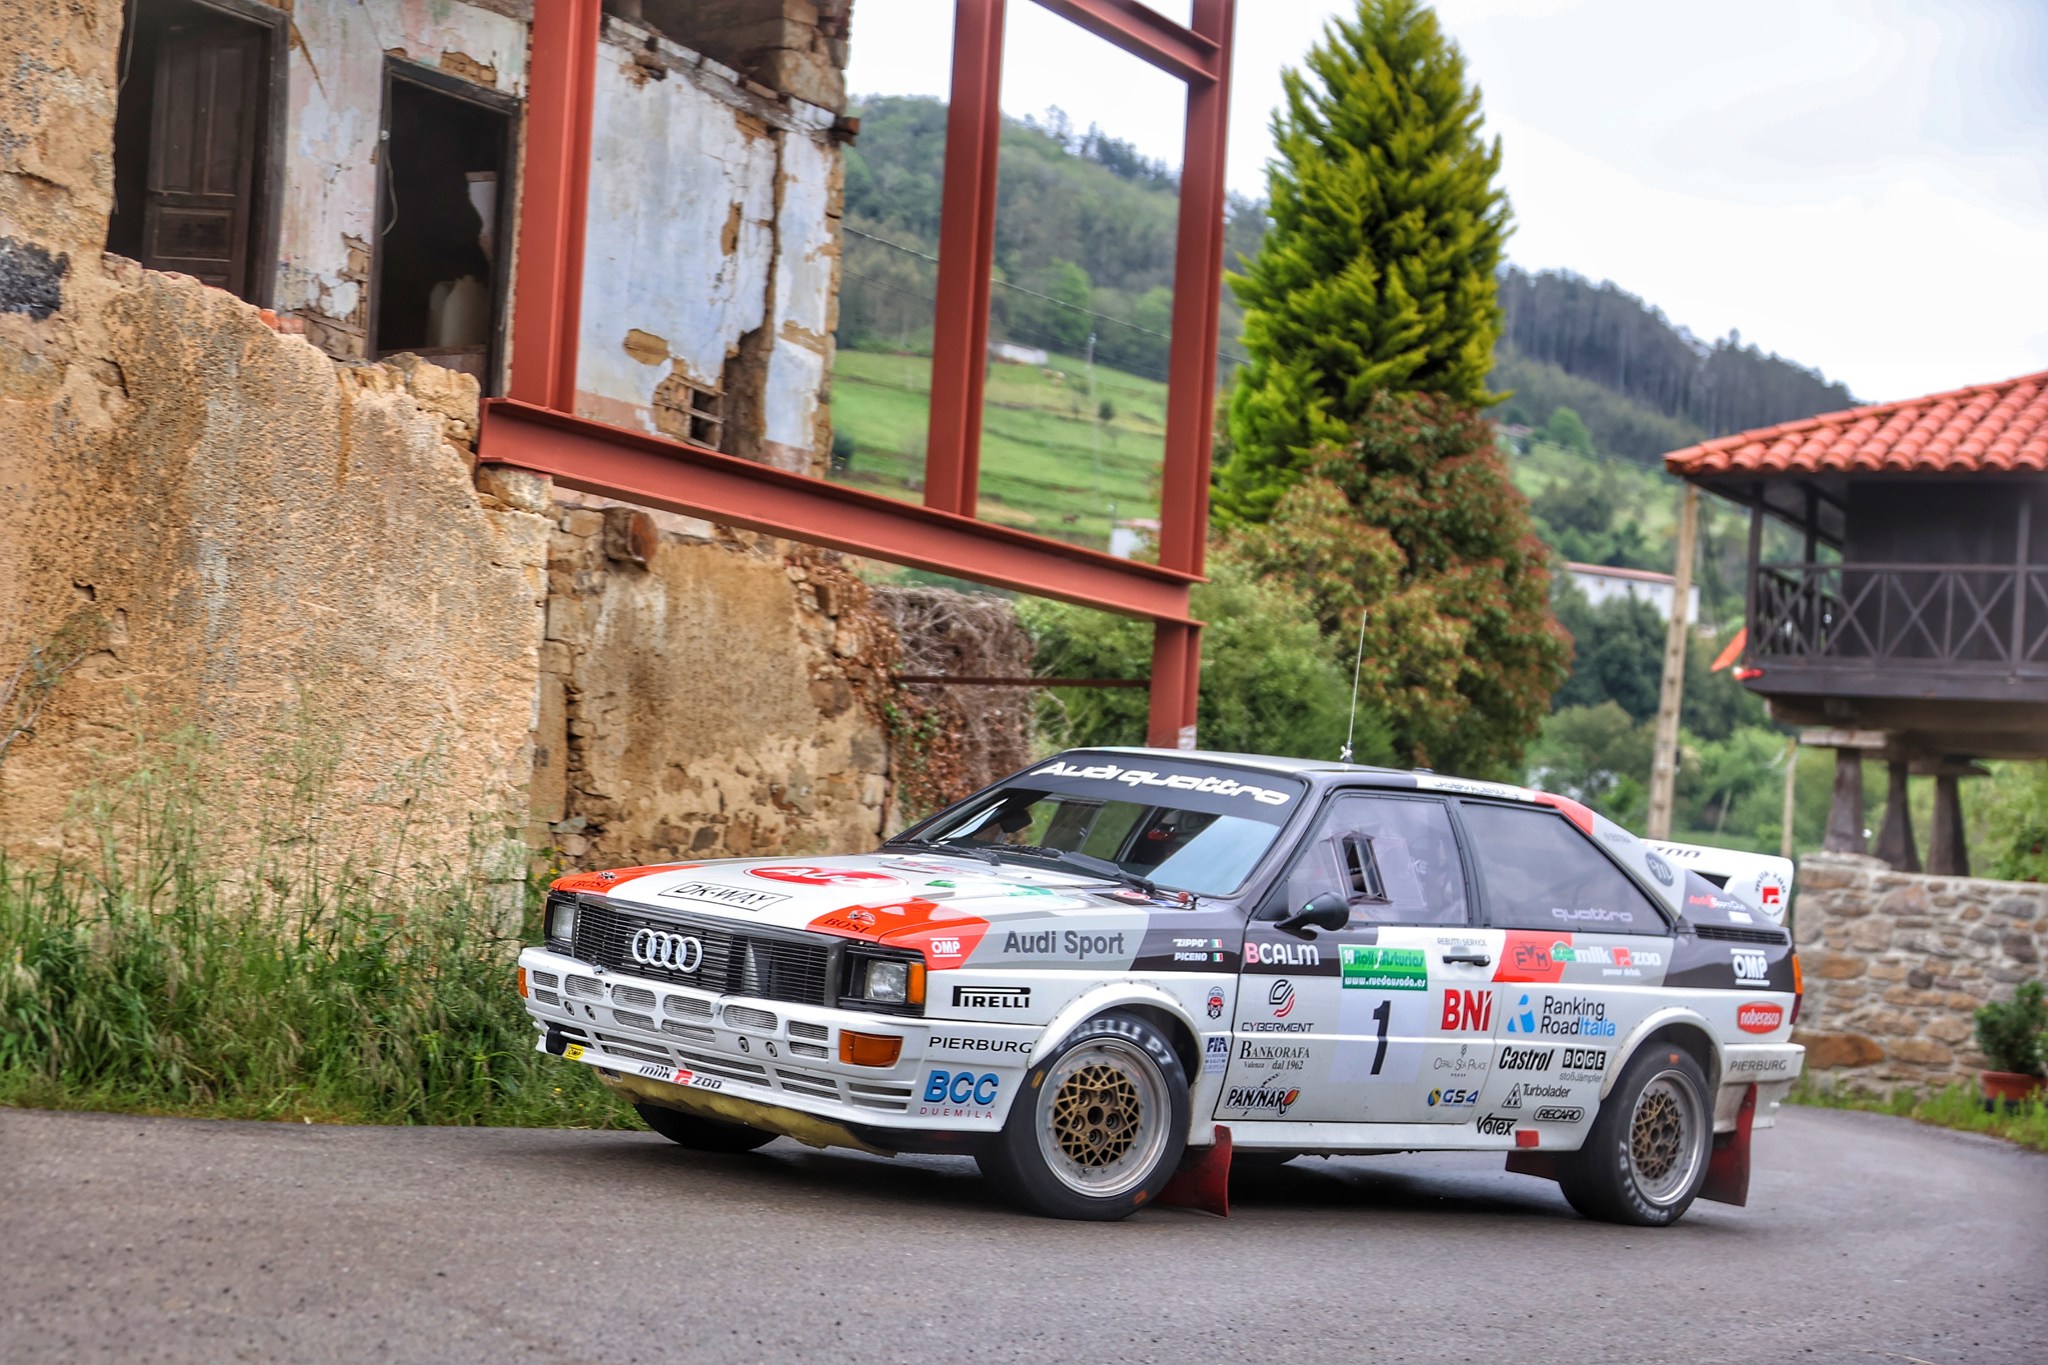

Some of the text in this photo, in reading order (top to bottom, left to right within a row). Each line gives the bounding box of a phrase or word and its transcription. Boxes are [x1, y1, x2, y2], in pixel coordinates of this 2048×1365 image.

[1030, 761, 1291, 805] Audi quattro
[1552, 907, 1633, 923] quattro
[931, 941, 960, 953] OMP
[1003, 930, 1124, 959] Audi Sport
[1174, 952, 1207, 962] PICENO
[1244, 942, 1319, 966] BCALM
[1380, 950, 1424, 967] Asturias
[1575, 946, 1612, 964] milk
[1631, 951, 1662, 966] zoo
[1733, 955, 1768, 979] OMP
[952, 986, 1031, 1008] PIRELLI
[1441, 989, 1492, 1032] BNI
[1543, 995, 1605, 1021] Ranking
[1741, 1008, 1780, 1026] noberasco
[1241, 1022, 1314, 1032] CYBERMENT
[929, 1036, 1033, 1054] PIERBURG
[1207, 1037, 1228, 1053] FIA
[1370, 1000, 1391, 1075] 1
[567, 1048, 582, 1058] OMP
[1239, 1041, 1310, 1059] BANKORAFA
[1499, 1046, 1555, 1071] Castrol
[1272, 1060, 1285, 1070] dal
[1286, 1060, 1304, 1070] 1962
[1563, 1049, 1606, 1070] BOGE
[1730, 1060, 1787, 1072] PIERBURG
[638, 1064, 723, 1090] milk zoo
[1443, 1089, 1479, 1104] GS4
[1523, 1083, 1571, 1098] Turbolader
[919, 1105, 993, 1120] DUEMILA
[1538, 1108, 1581, 1120] RECARO
[1476, 1113, 1519, 1136] Votex
